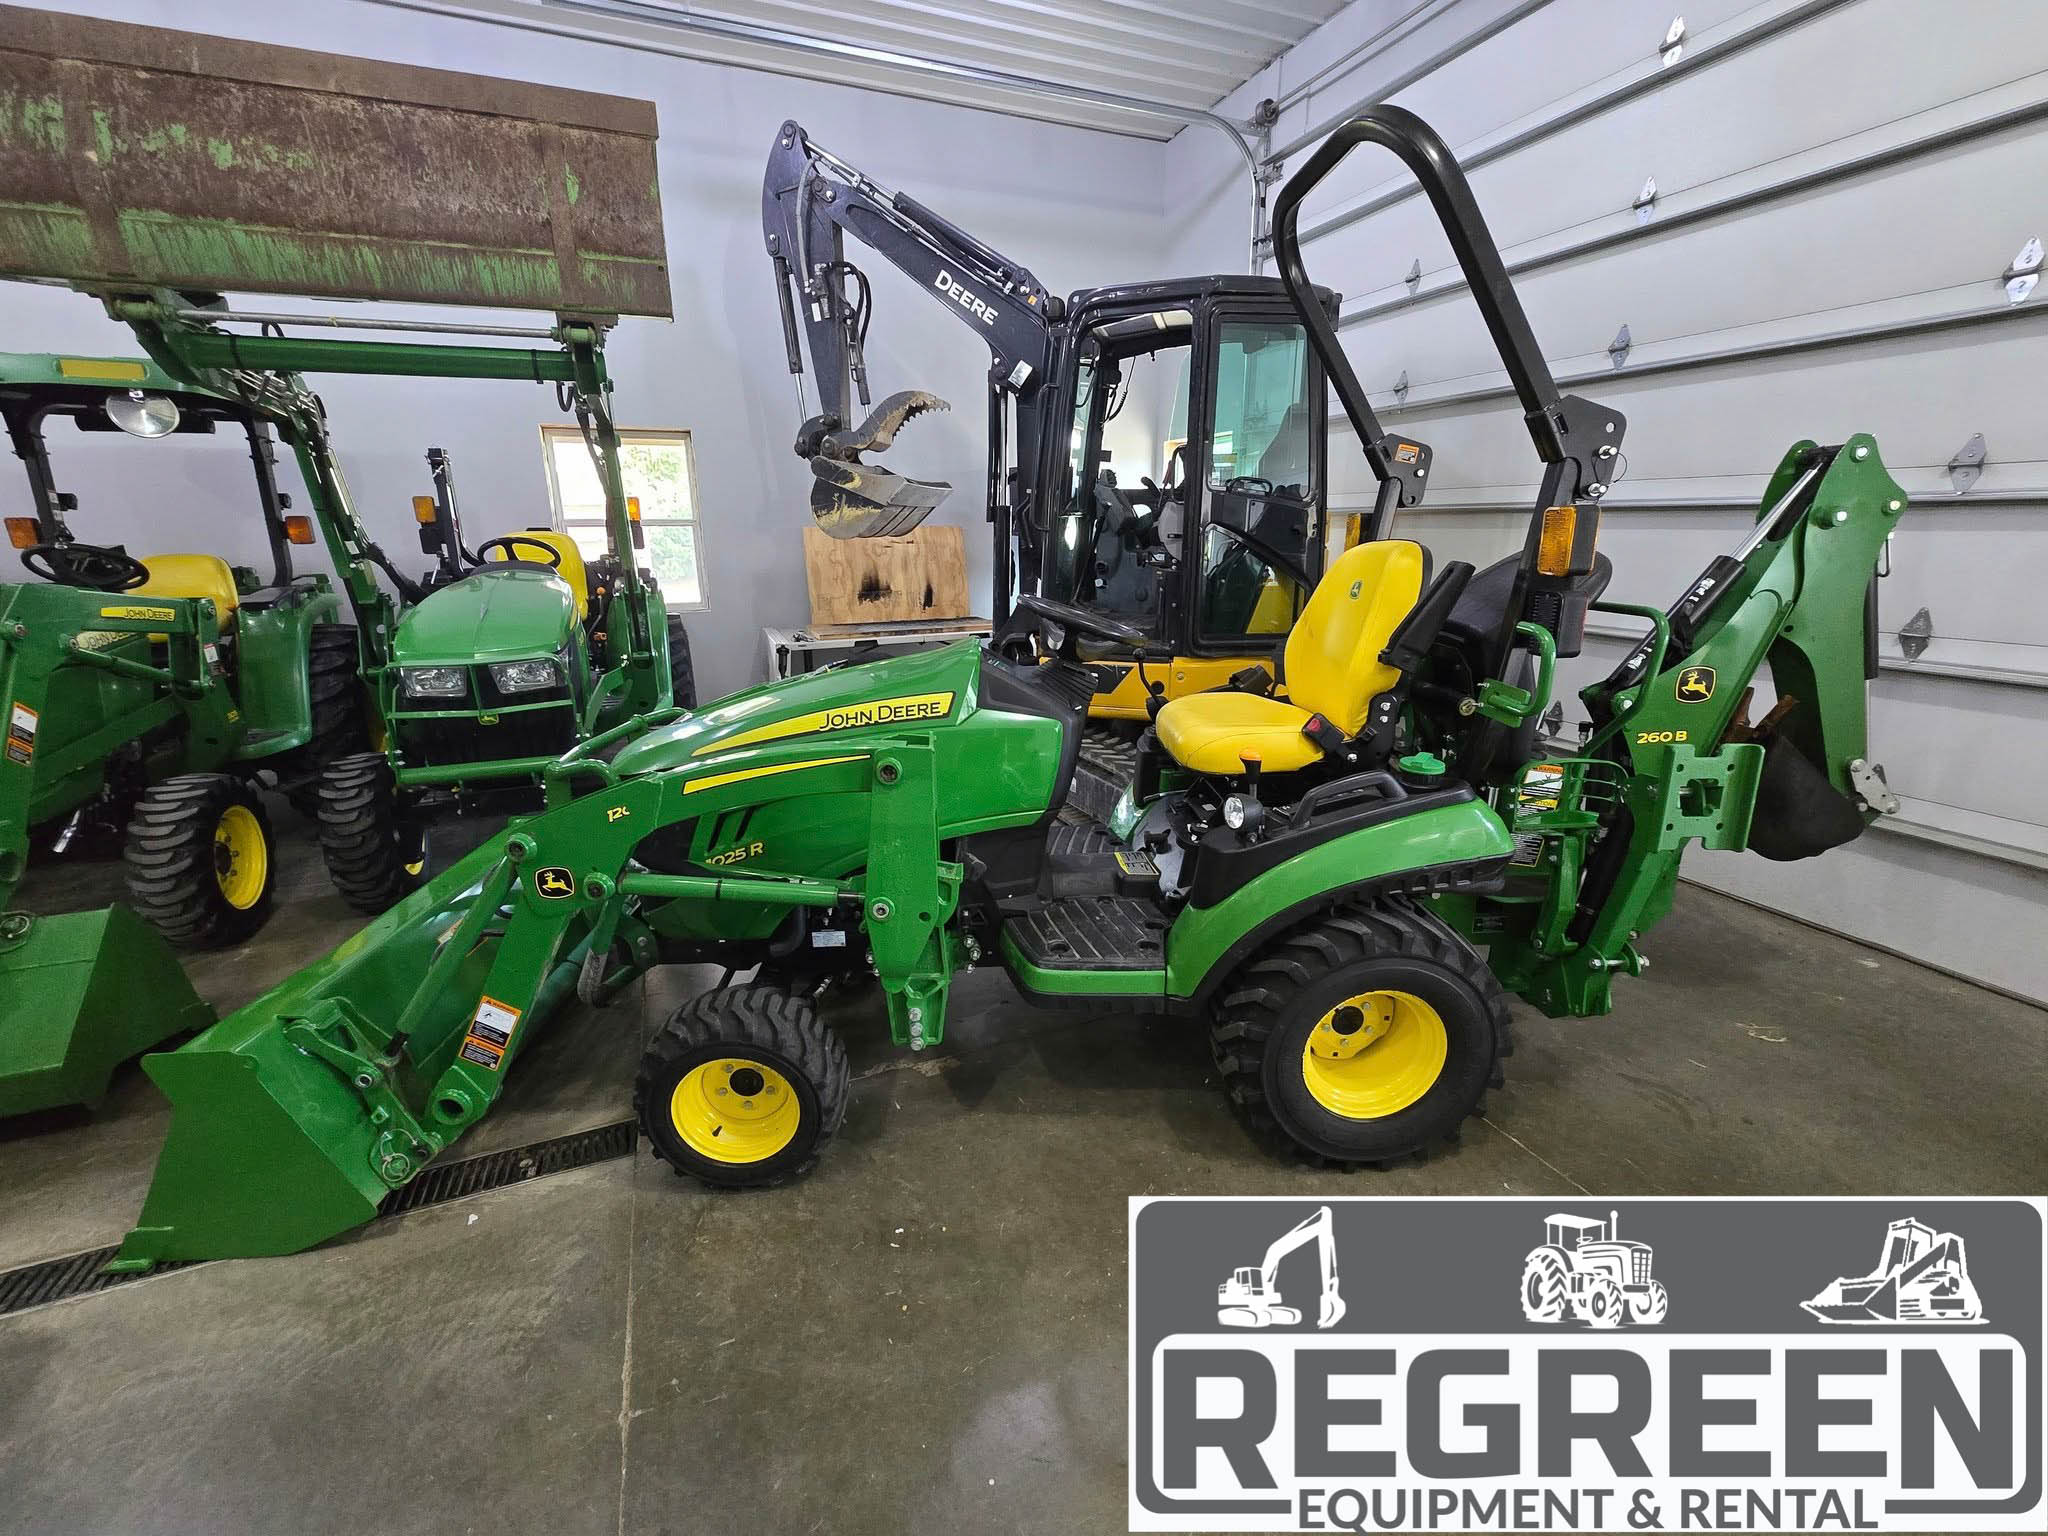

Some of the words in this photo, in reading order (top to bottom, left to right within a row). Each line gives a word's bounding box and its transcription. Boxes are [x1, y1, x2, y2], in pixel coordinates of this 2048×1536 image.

[934, 269, 999, 326] DEERE
[123, 608, 146, 618] JOHN
[148, 608, 173, 621] DEERE
[819, 709, 873, 730] JOHN
[877, 702, 941, 721] DEERE
[1636, 731, 1673, 744] 260
[1675, 730, 1688, 742] B
[750, 842, 764, 857] R
